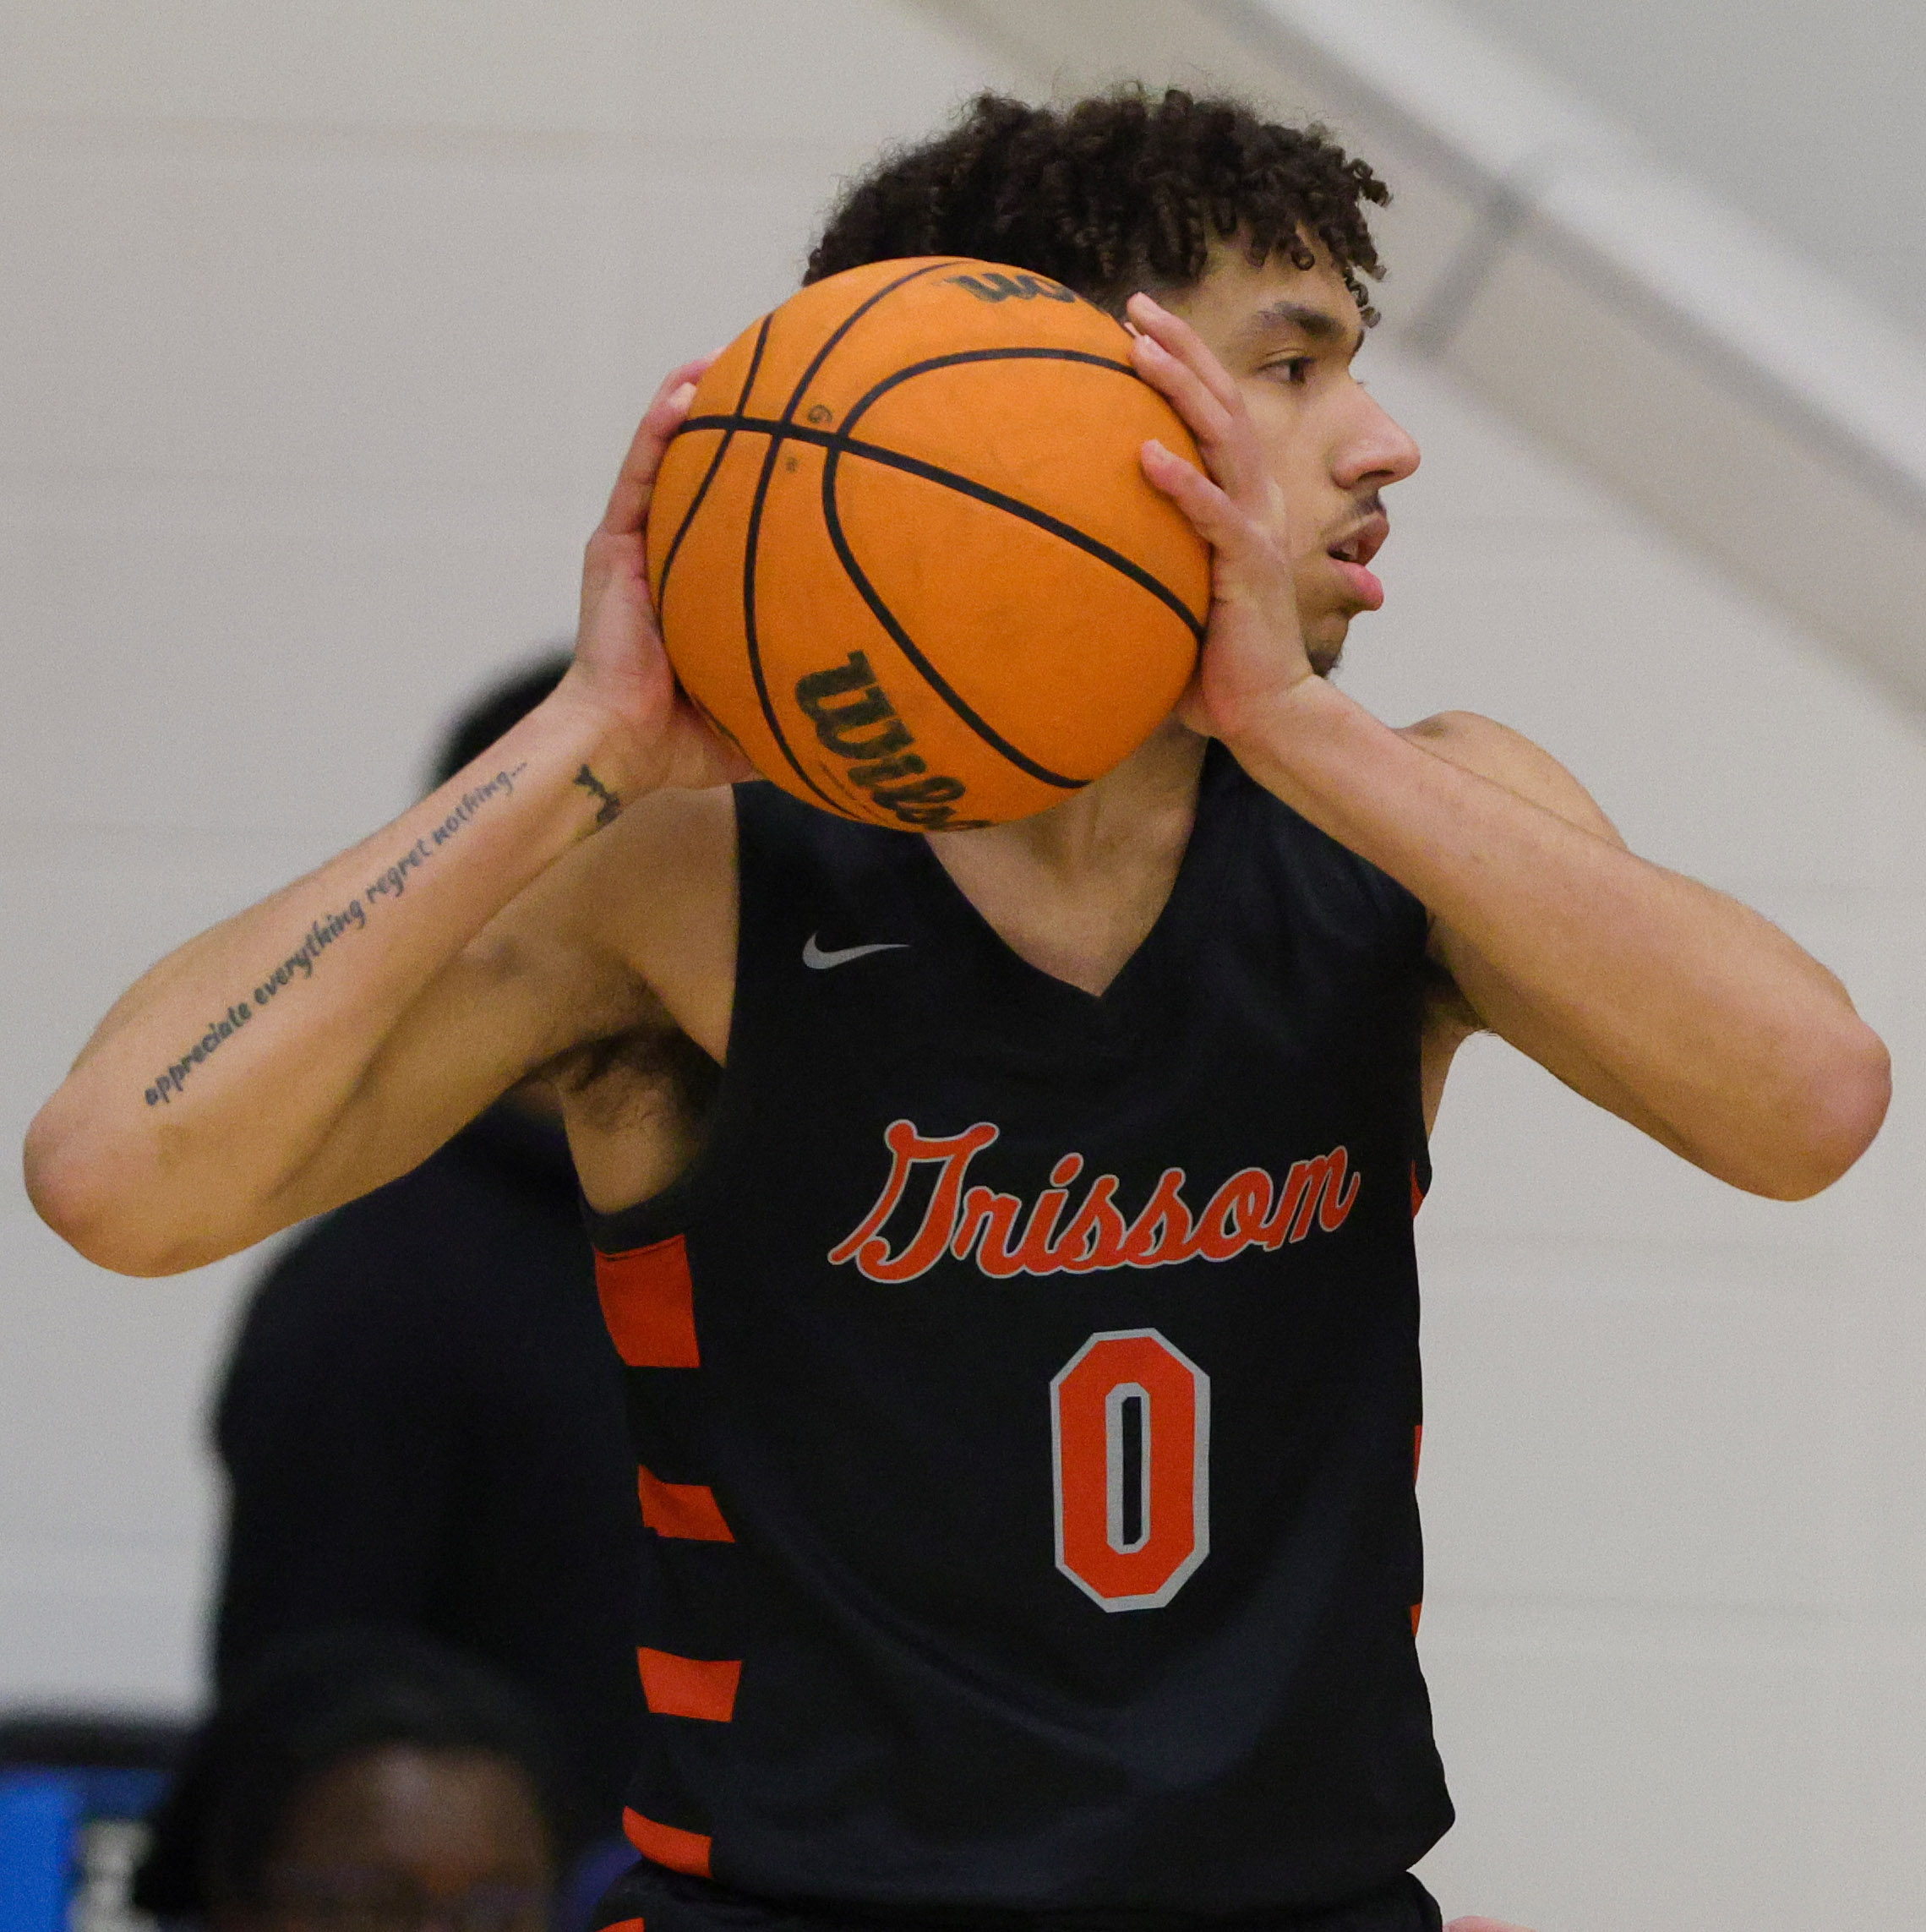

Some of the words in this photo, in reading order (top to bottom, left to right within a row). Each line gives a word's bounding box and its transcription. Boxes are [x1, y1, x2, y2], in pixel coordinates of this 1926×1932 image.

[145, 1002, 252, 1105] appreciate
[254, 898, 367, 1004] everything
[366, 838, 433, 904] regret
[827, 1119, 1361, 1284] Grissom
[1050, 1327, 1211, 1613] 0
